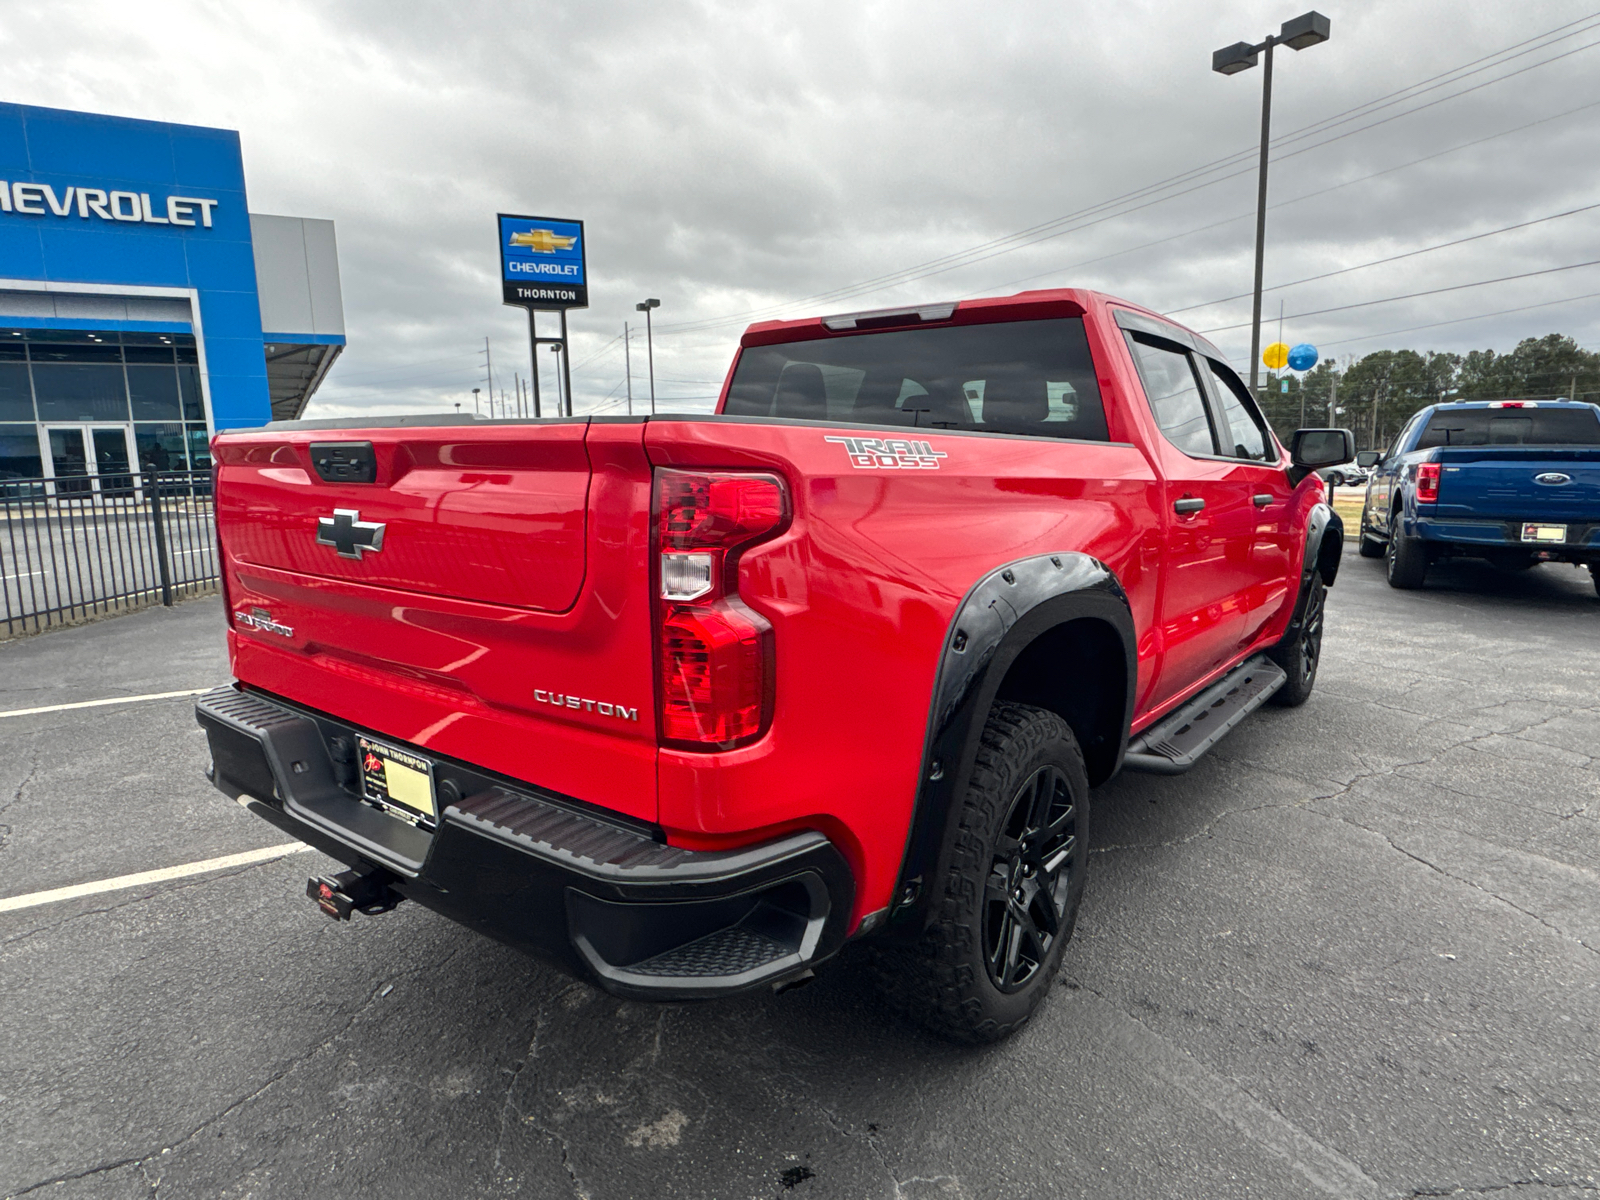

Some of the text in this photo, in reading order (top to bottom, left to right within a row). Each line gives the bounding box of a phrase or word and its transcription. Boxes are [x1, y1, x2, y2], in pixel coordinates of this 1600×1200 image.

[508, 261, 579, 276] CHEVROLET
[517, 288, 576, 300] THORNTON
[824, 435, 948, 458] TRAIL
[850, 453, 940, 469] BOSS
[533, 689, 638, 721] CUSTOM
